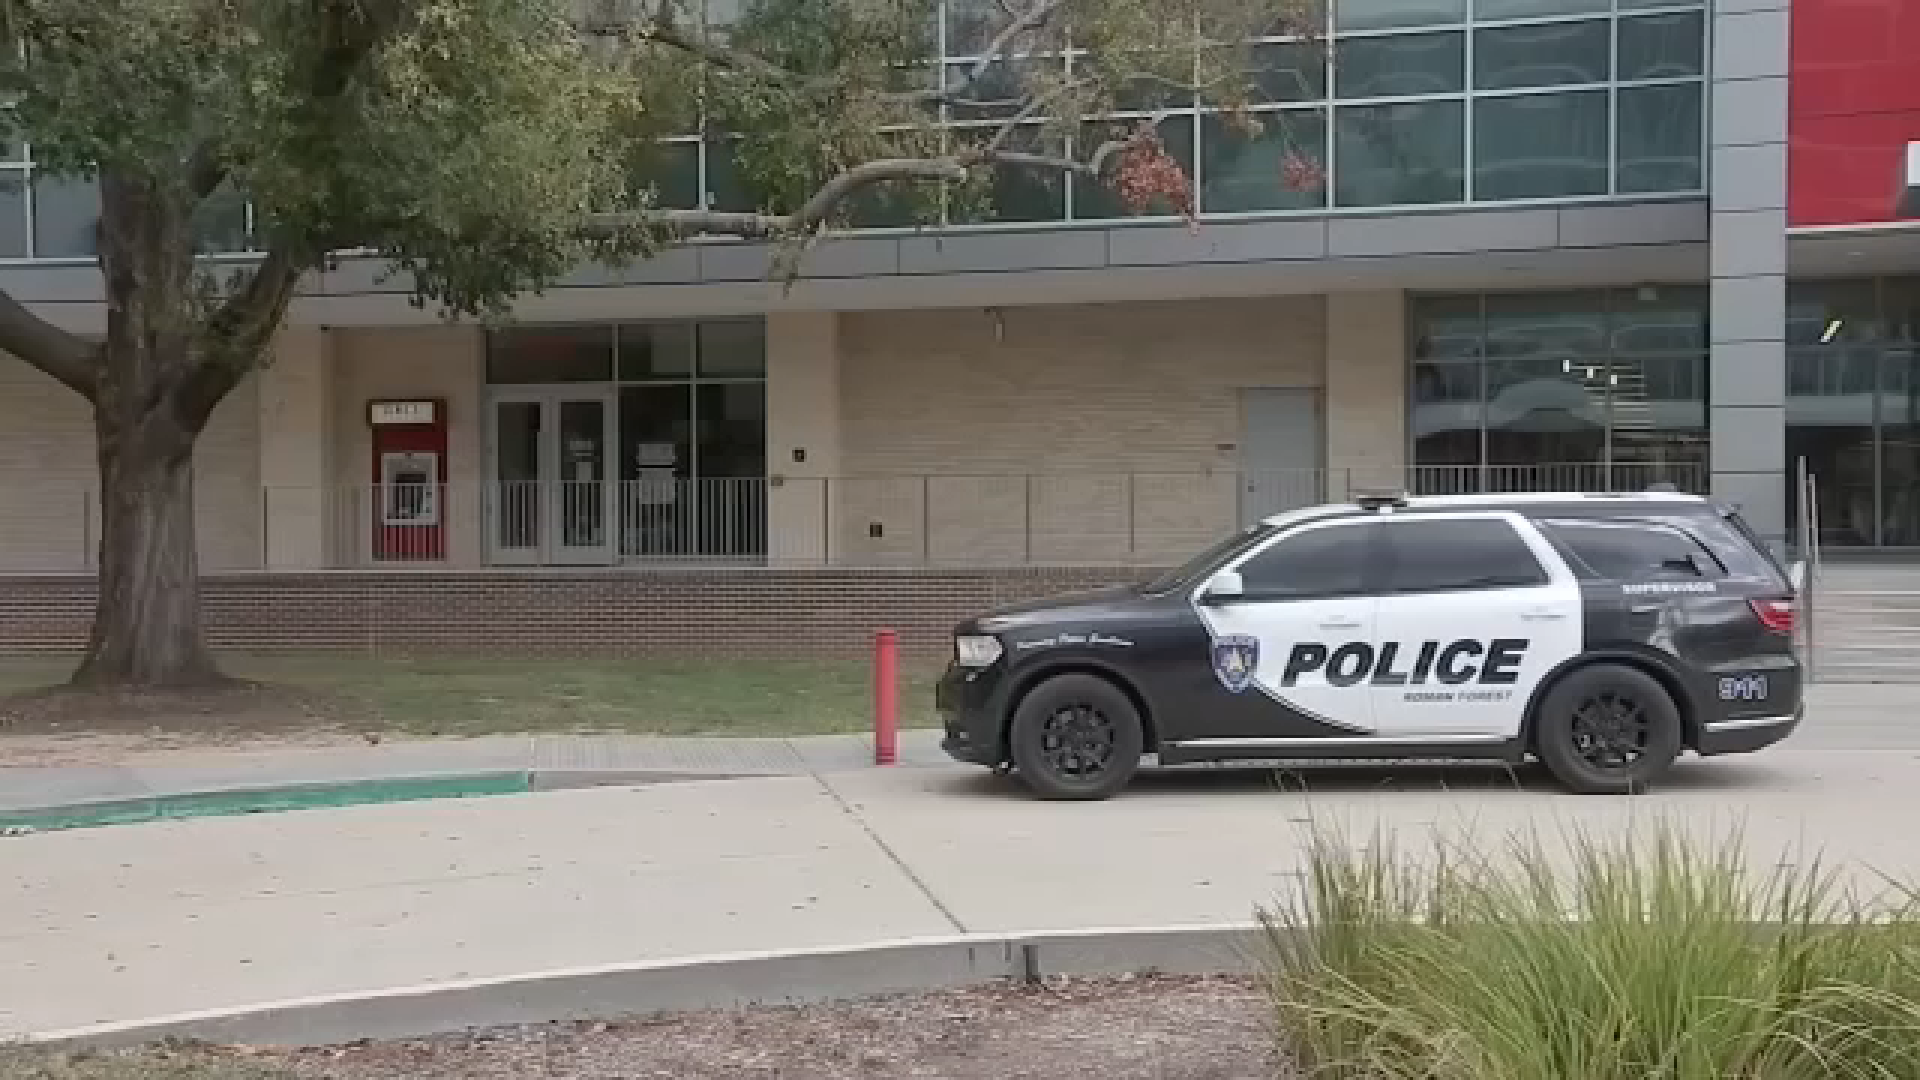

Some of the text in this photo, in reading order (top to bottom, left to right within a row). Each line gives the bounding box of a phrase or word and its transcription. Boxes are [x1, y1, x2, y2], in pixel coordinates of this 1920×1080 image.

[1281, 638, 1530, 687] POLICE
[1457, 689, 1513, 702] FOREST
[1718, 676, 1768, 700] 911
